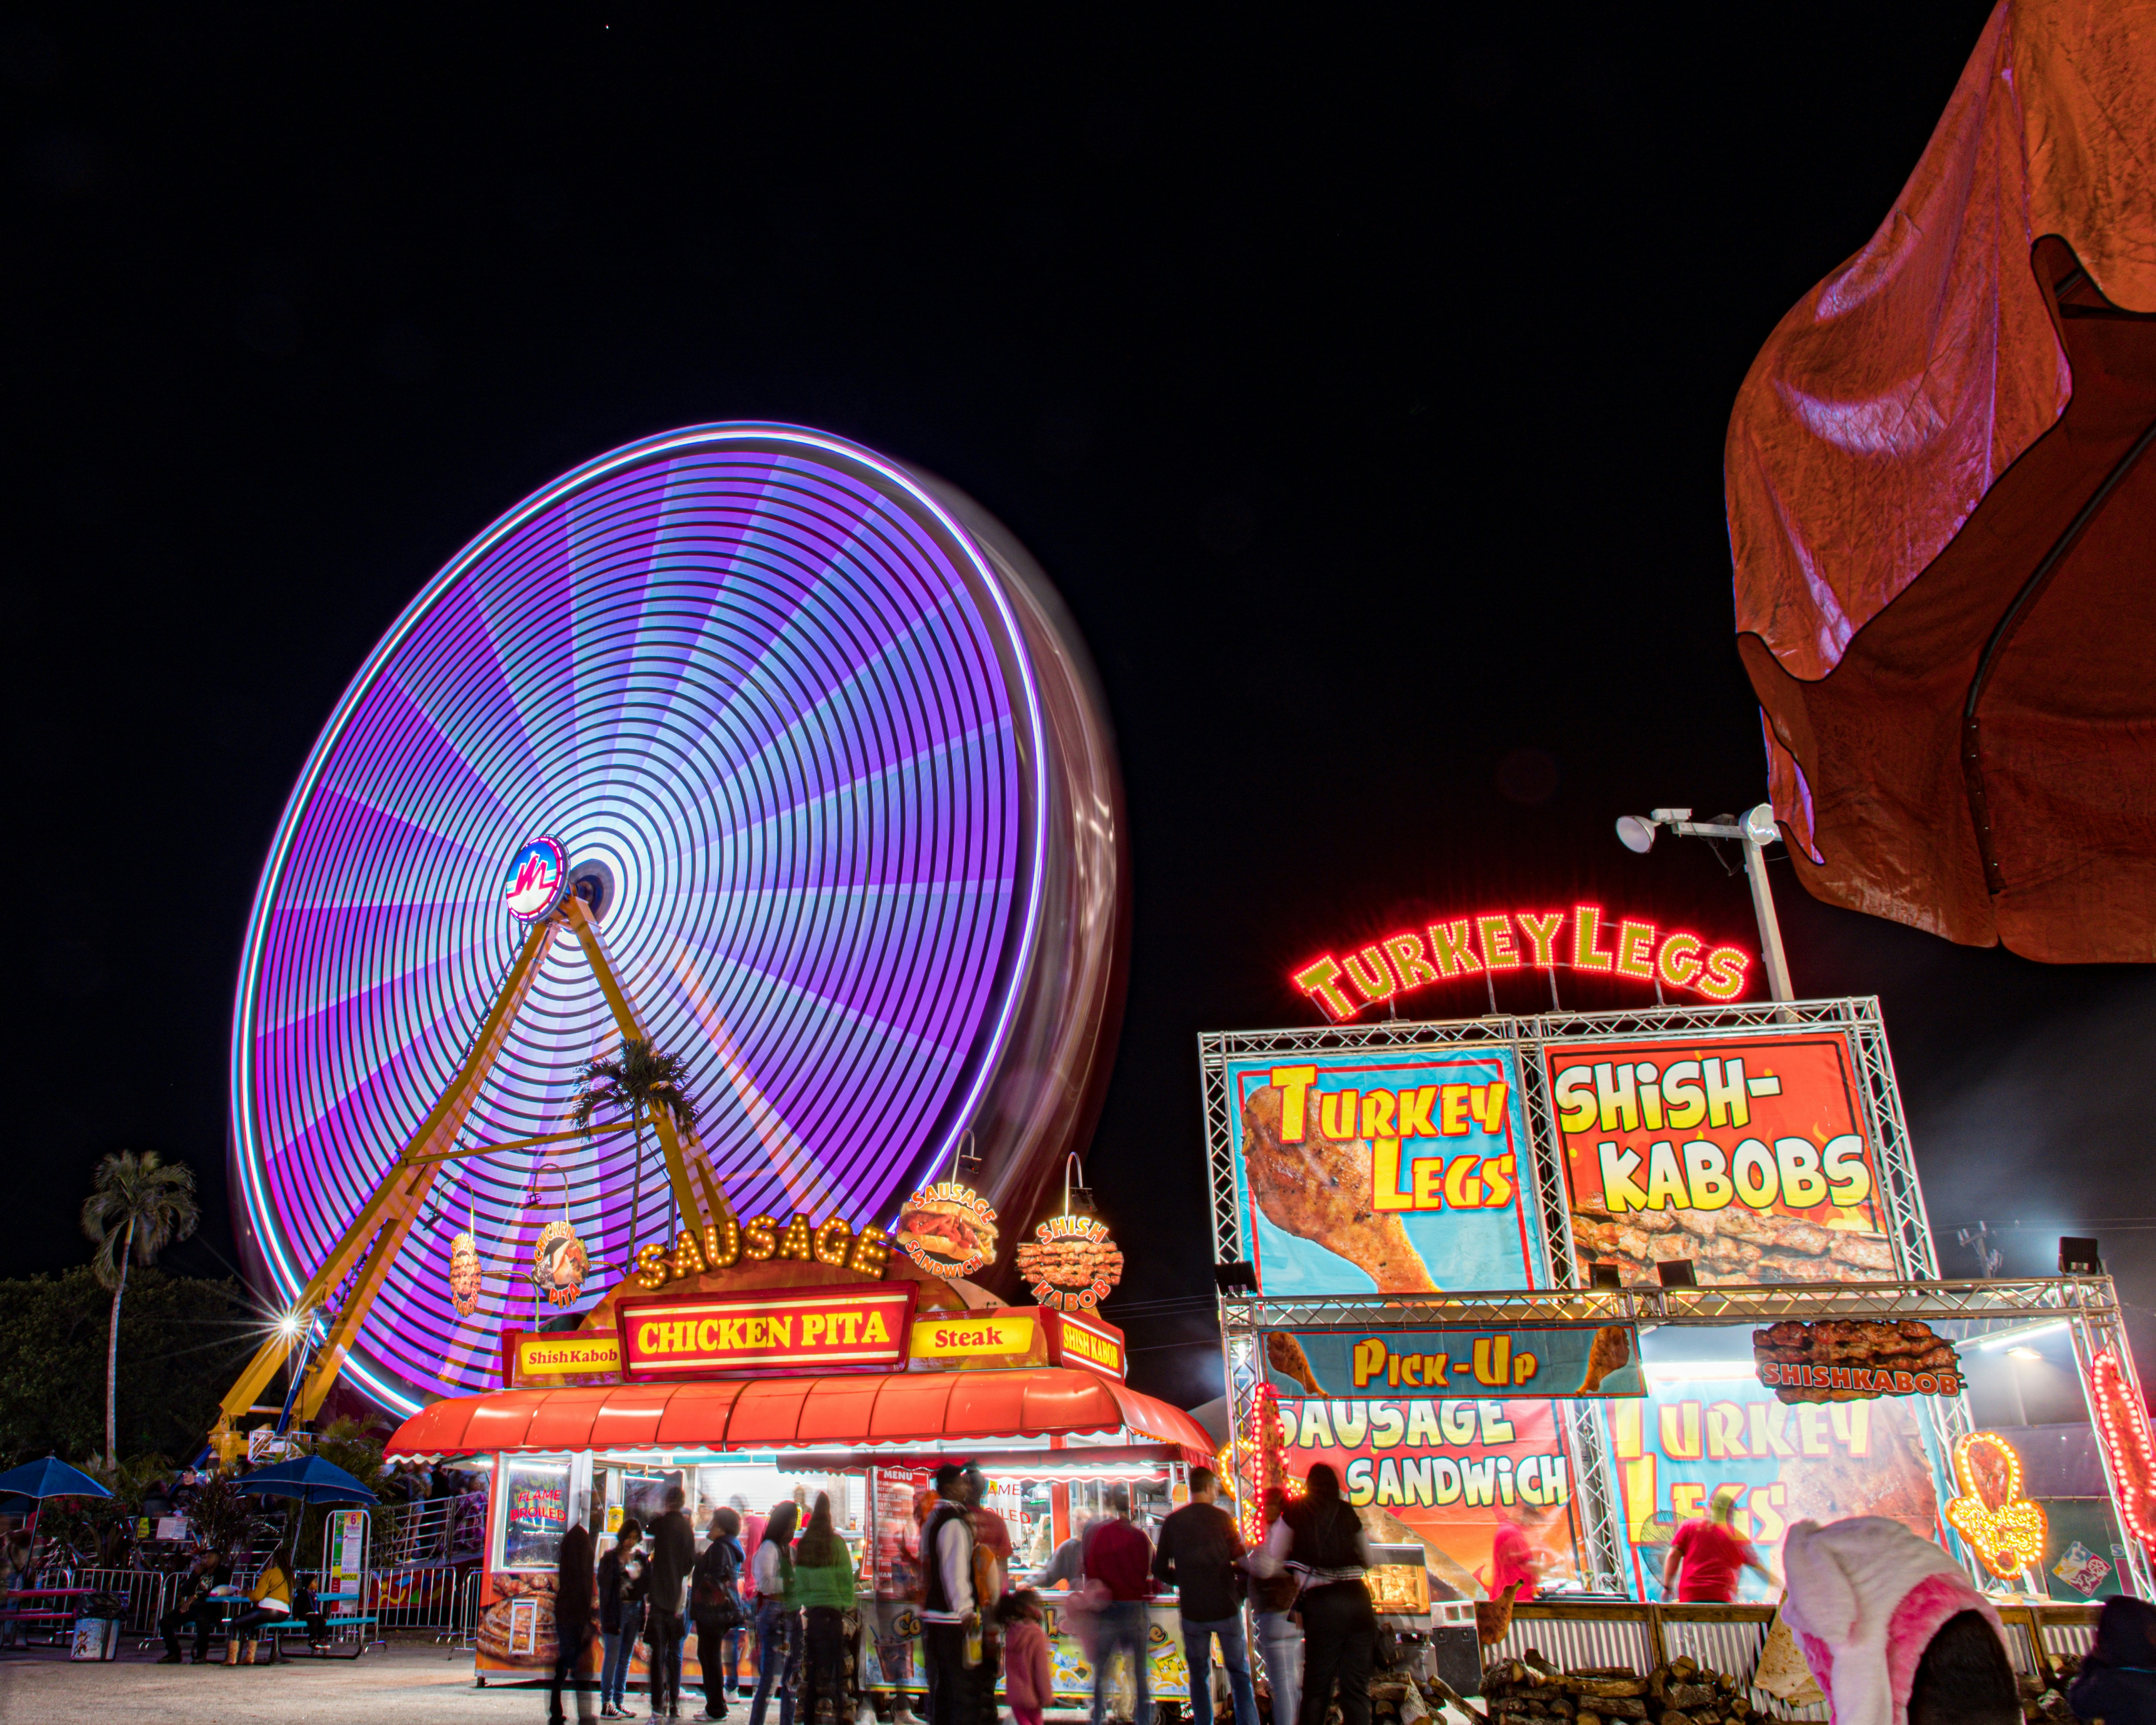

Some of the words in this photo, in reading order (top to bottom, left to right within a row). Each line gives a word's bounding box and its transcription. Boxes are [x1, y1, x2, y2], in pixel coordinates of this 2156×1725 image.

[1293, 913, 1564, 1021] TURKEY
[1571, 905, 1751, 1001] LEGS
[1270, 1064, 1510, 1144] TURKEY
[1372, 1136, 1516, 1212] LEGS
[1597, 1134, 1874, 1213] KABOBS
[910, 1181, 998, 1225] SAUSAGE
[451, 1232, 476, 1259] SHISH
[534, 1220, 577, 1263] CHICKEN
[1036, 1215, 1109, 1245] SHISH
[636, 1211, 891, 1290] SAUSAGE
[905, 1240, 984, 1278] SANDWICH
[451, 1288, 479, 1318] KABOB
[549, 1281, 582, 1309] PITA
[1031, 1279, 1111, 1312] KABOB
[638, 1314, 793, 1356] CHICKEN
[802, 1310, 890, 1347] PITA
[935, 1326, 1003, 1348] Steak
[1063, 1323, 1090, 1358] SHISH
[1090, 1337, 1118, 1369] KABOB
[1353, 1334, 1538, 1387] PICK-UP
[1762, 1363, 1960, 1397] SHISHKABOB
[884, 1470, 913, 1481] MENU
[980, 1484, 1021, 1498] AME
[518, 1489, 562, 1504] FLAME
[351, 1514, 356, 1524] 6
[510, 1507, 567, 1522] BROILED
[1958, 1505, 2037, 1536] Turkey
[1156, 1652, 1177, 1663] LEMONADE
